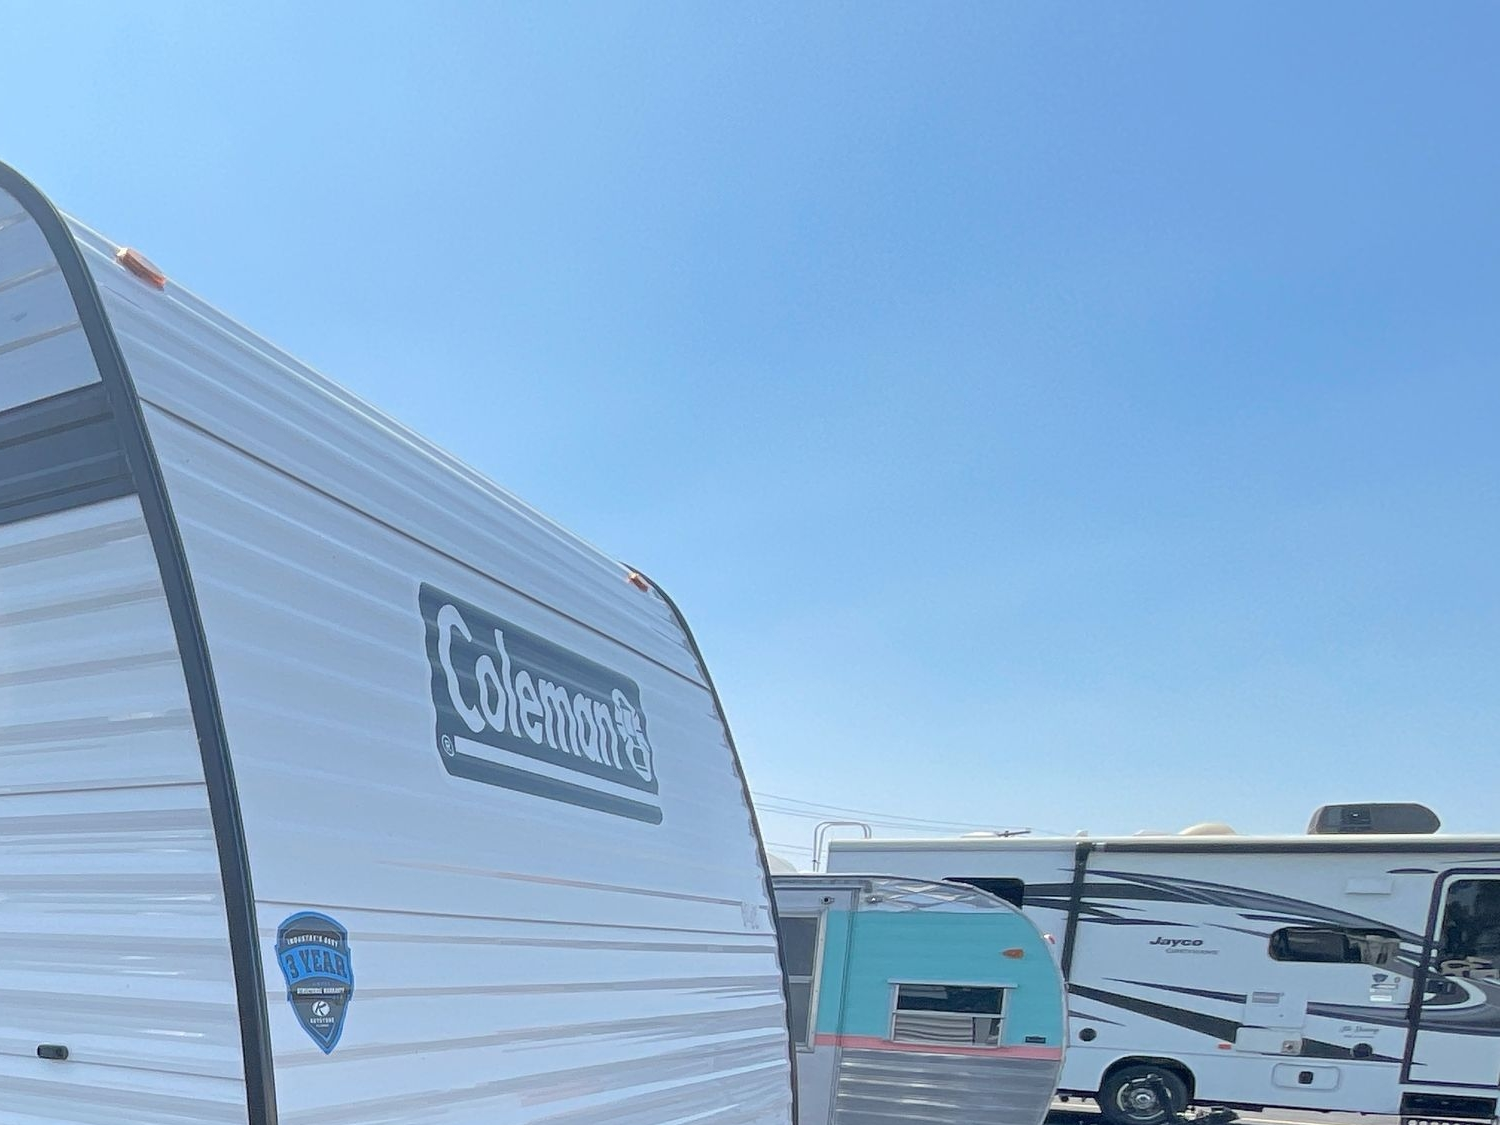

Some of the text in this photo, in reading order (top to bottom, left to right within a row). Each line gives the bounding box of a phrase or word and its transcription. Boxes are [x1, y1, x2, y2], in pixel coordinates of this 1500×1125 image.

[436, 603, 624, 770] Coleman
[1149, 936, 1204, 948] Jayco
[285, 948, 348, 978] 3 YEAR
